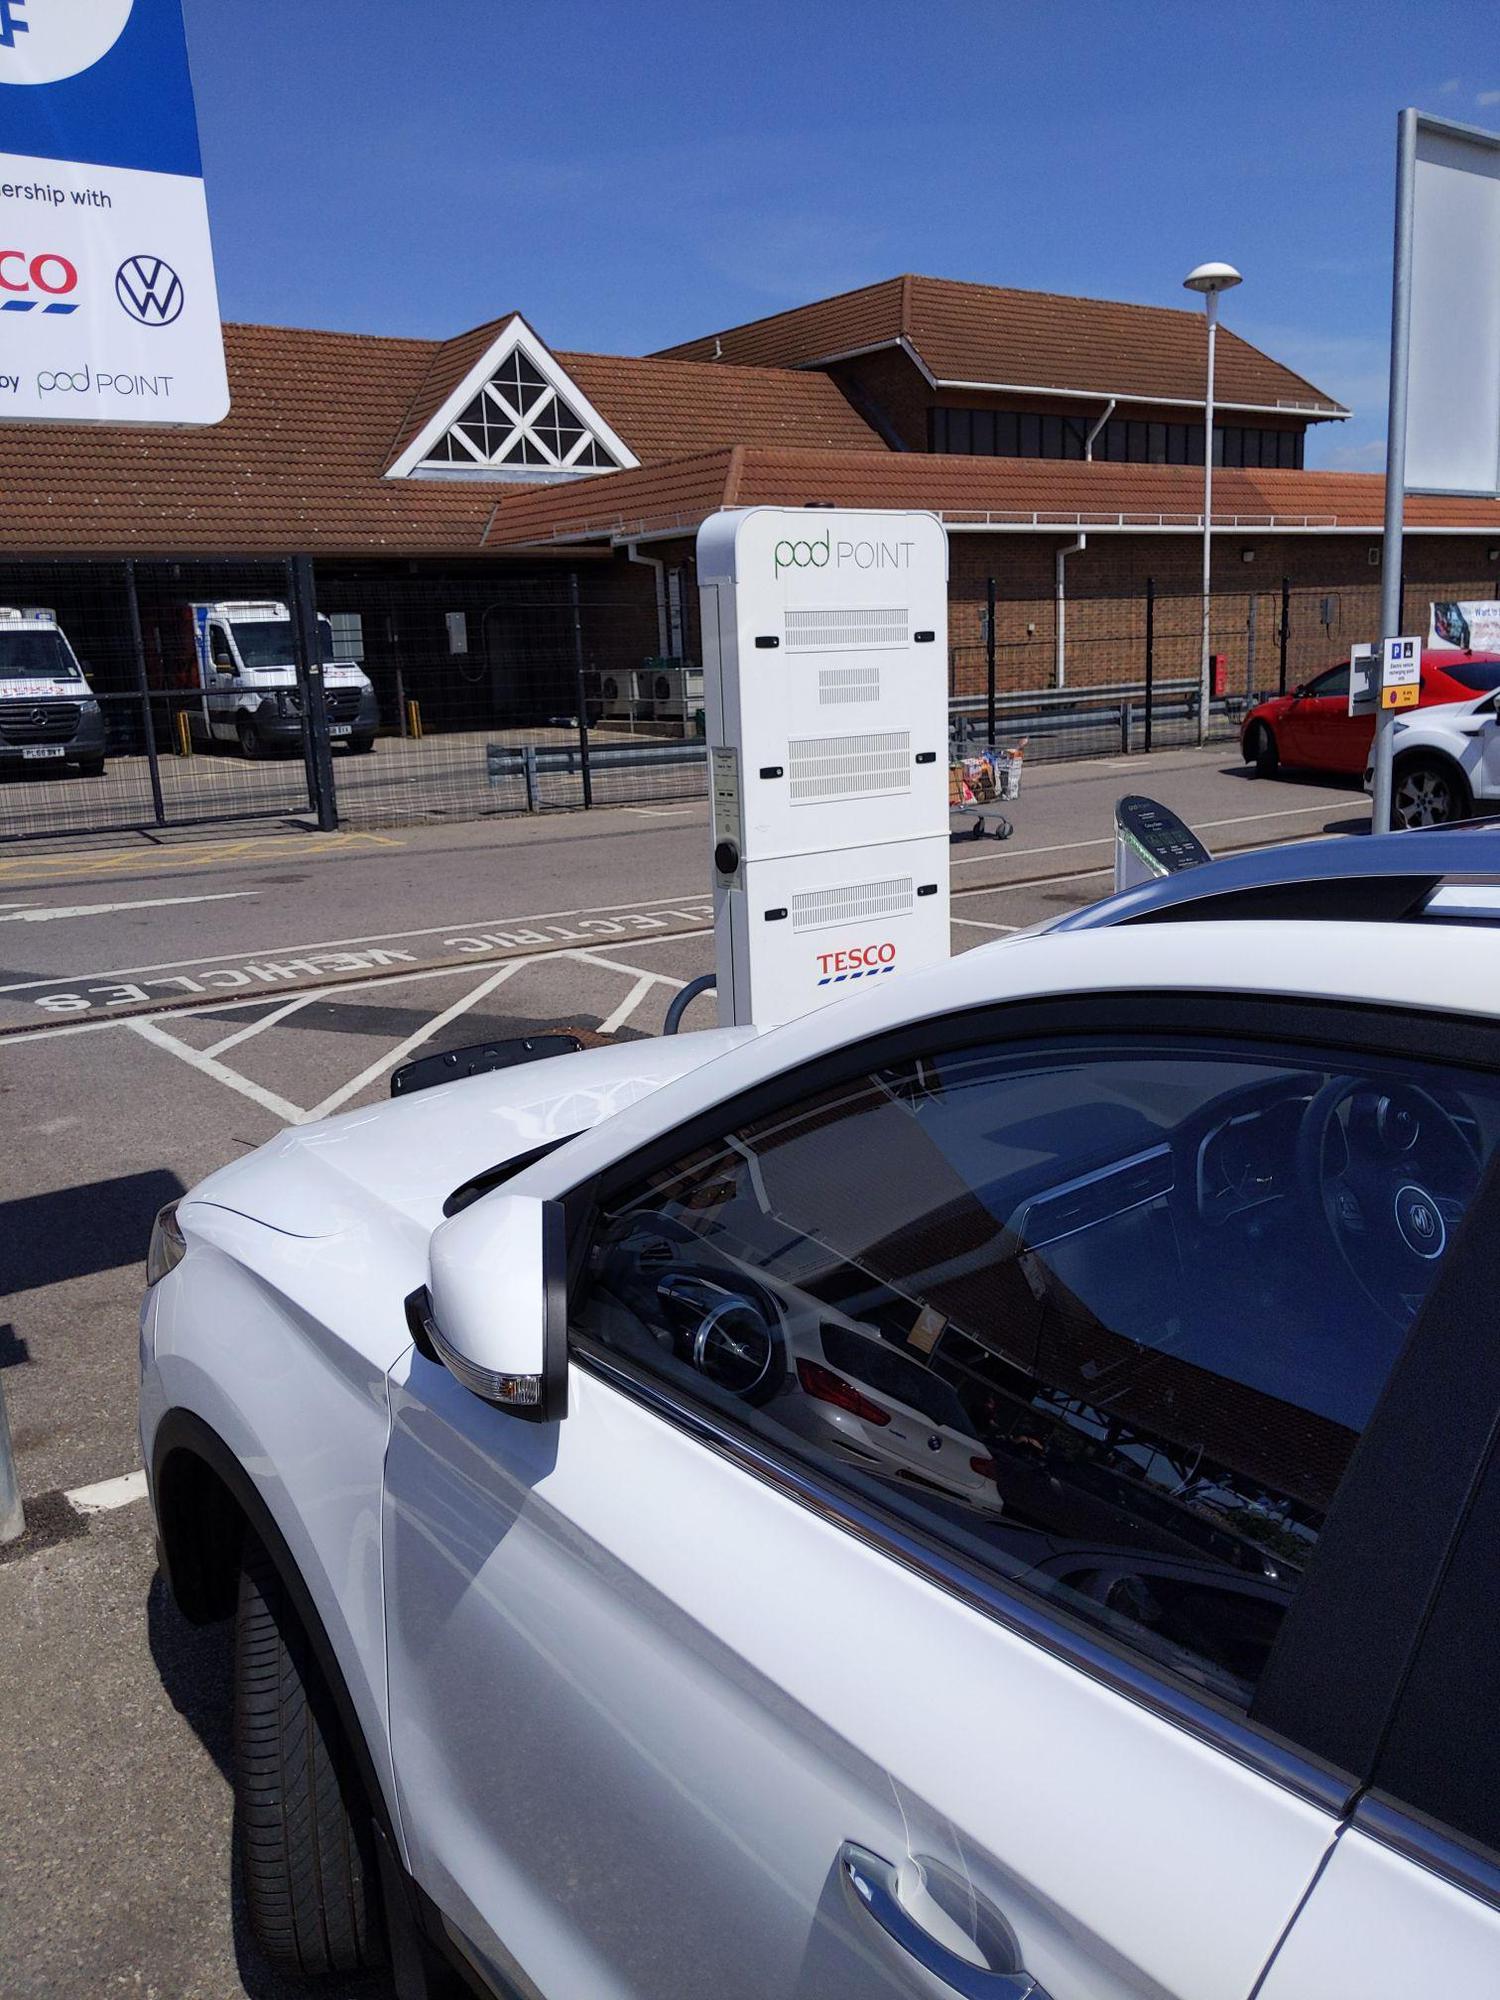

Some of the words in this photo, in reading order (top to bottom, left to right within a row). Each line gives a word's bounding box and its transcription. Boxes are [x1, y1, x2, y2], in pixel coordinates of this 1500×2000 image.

[0, 183, 65, 207] ership
[70, 189, 112, 208] with
[37, 363, 90, 399] pod
[96, 373, 173, 396] POINT
[774, 528, 830, 580] pod
[837, 541, 915, 569] POINT
[816, 943, 896, 974] TESCO
